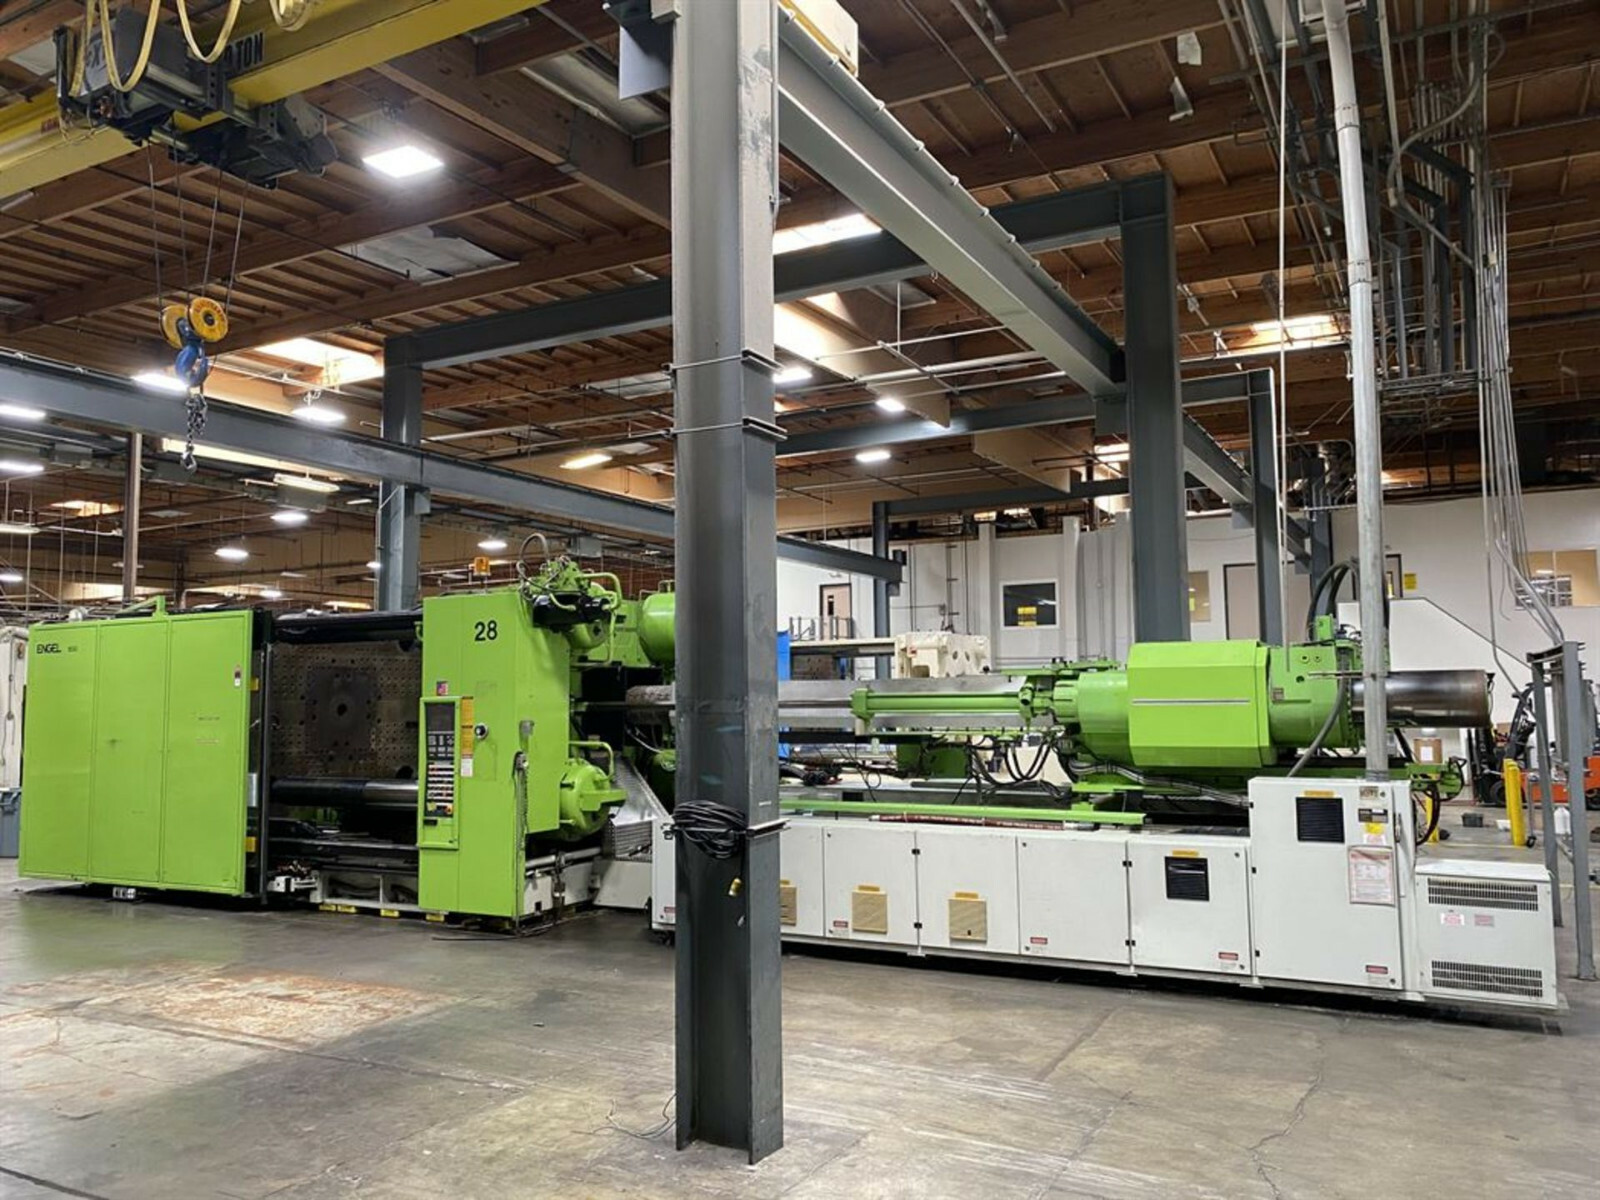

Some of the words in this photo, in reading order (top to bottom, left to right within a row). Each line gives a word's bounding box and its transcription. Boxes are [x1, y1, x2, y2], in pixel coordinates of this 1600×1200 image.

[235, 32, 264, 71] TON
[474, 620, 498, 641] 28
[36, 643, 62, 655] ENGEL
